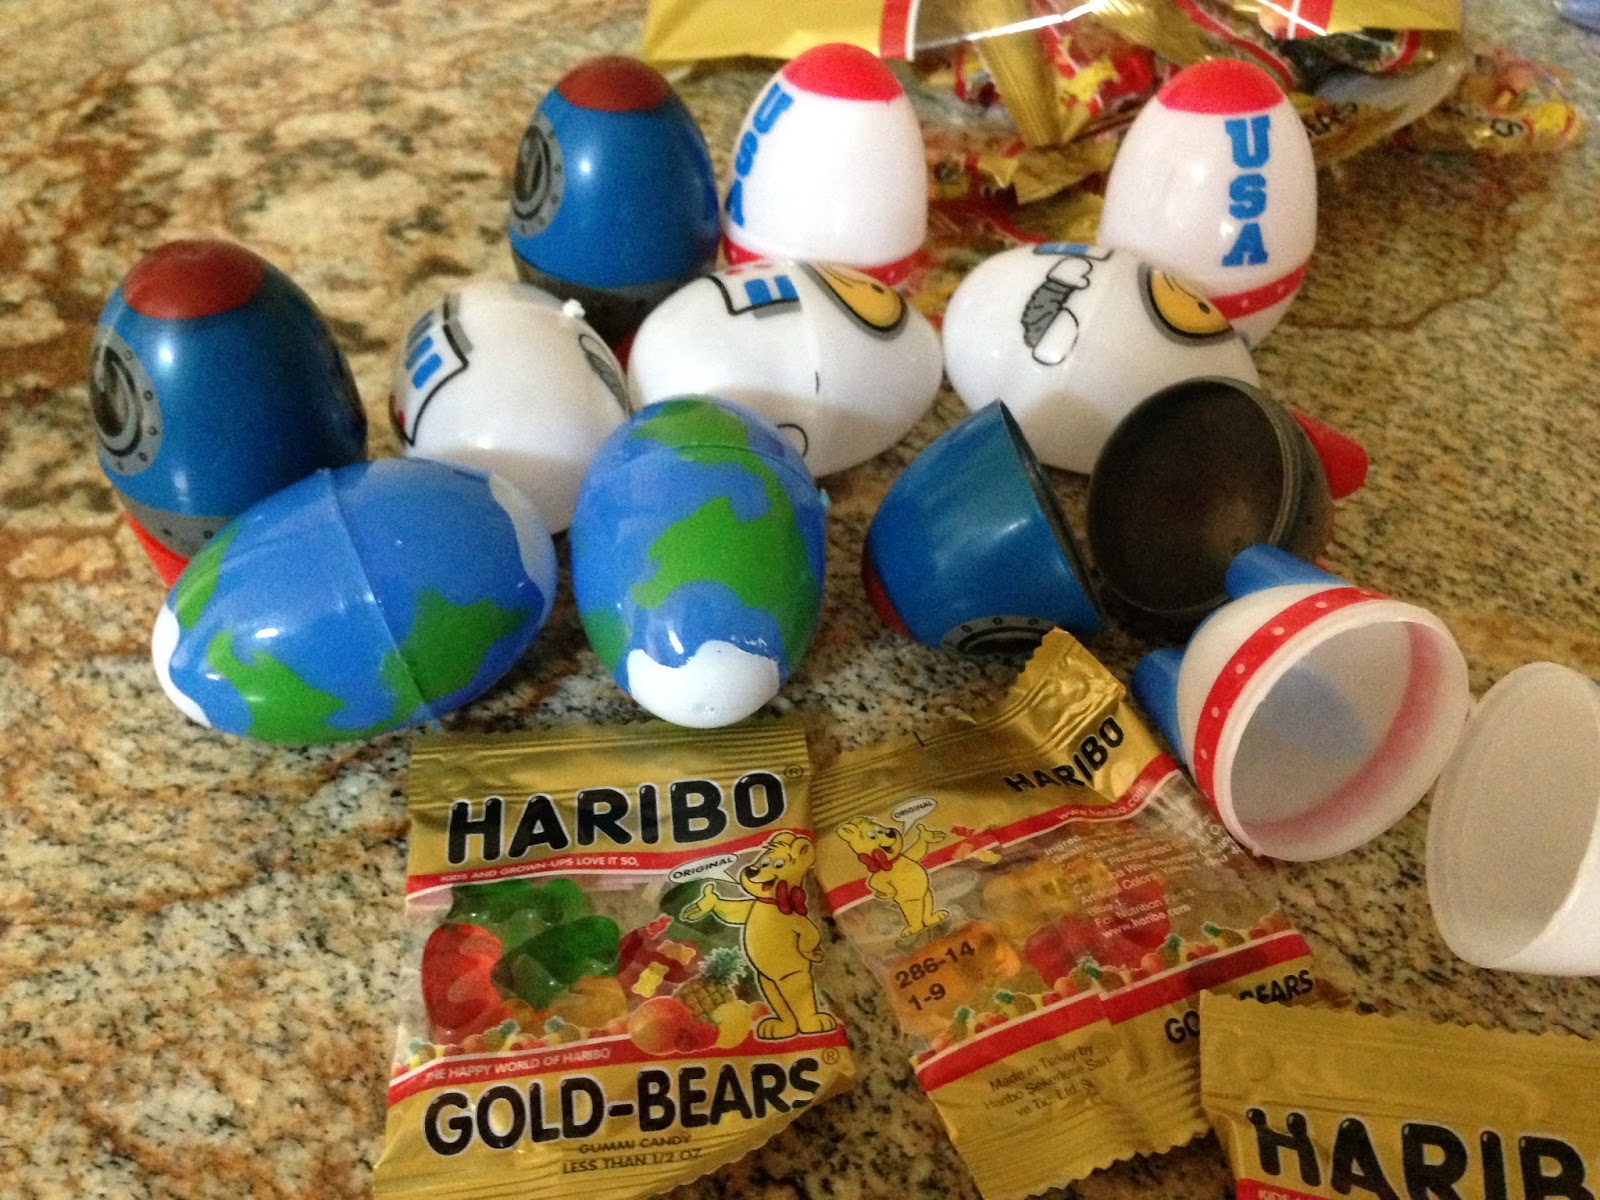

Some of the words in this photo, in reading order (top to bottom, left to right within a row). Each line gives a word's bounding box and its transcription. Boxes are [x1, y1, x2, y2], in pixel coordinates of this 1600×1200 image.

[725, 83, 793, 228] USA
[1221, 115, 1270, 268] USA
[1004, 717, 1124, 792] HARIBO
[447, 772, 786, 864] HARIBO
[894, 801, 933, 819] ORIGINAL
[472, 869, 498, 879] AND
[500, 858, 574, 876] GROWN-UPS
[577, 856, 605, 866] LOVE
[607, 856, 617, 865] IT
[673, 857, 734, 879] ORIGINAL
[895, 941, 976, 990] 286-14
[908, 983, 946, 1011] 1-9
[450, 1064, 492, 1079] HAPPY
[494, 1058, 540, 1074] WORLD
[543, 1056, 562, 1067] OF
[563, 1048, 611, 1064] HARIBO
[990, 1070, 1025, 1092] Made
[1077, 1044, 1094, 1056] by
[424, 1057, 820, 1156] GOLD-BEARS
[563, 1160, 597, 1174] LESS
[604, 1154, 646, 1169] THAN
[653, 1151, 674, 1164] 1/2
[579, 1139, 635, 1154] GUMMI
[640, 1134, 692, 1148] CANDY
